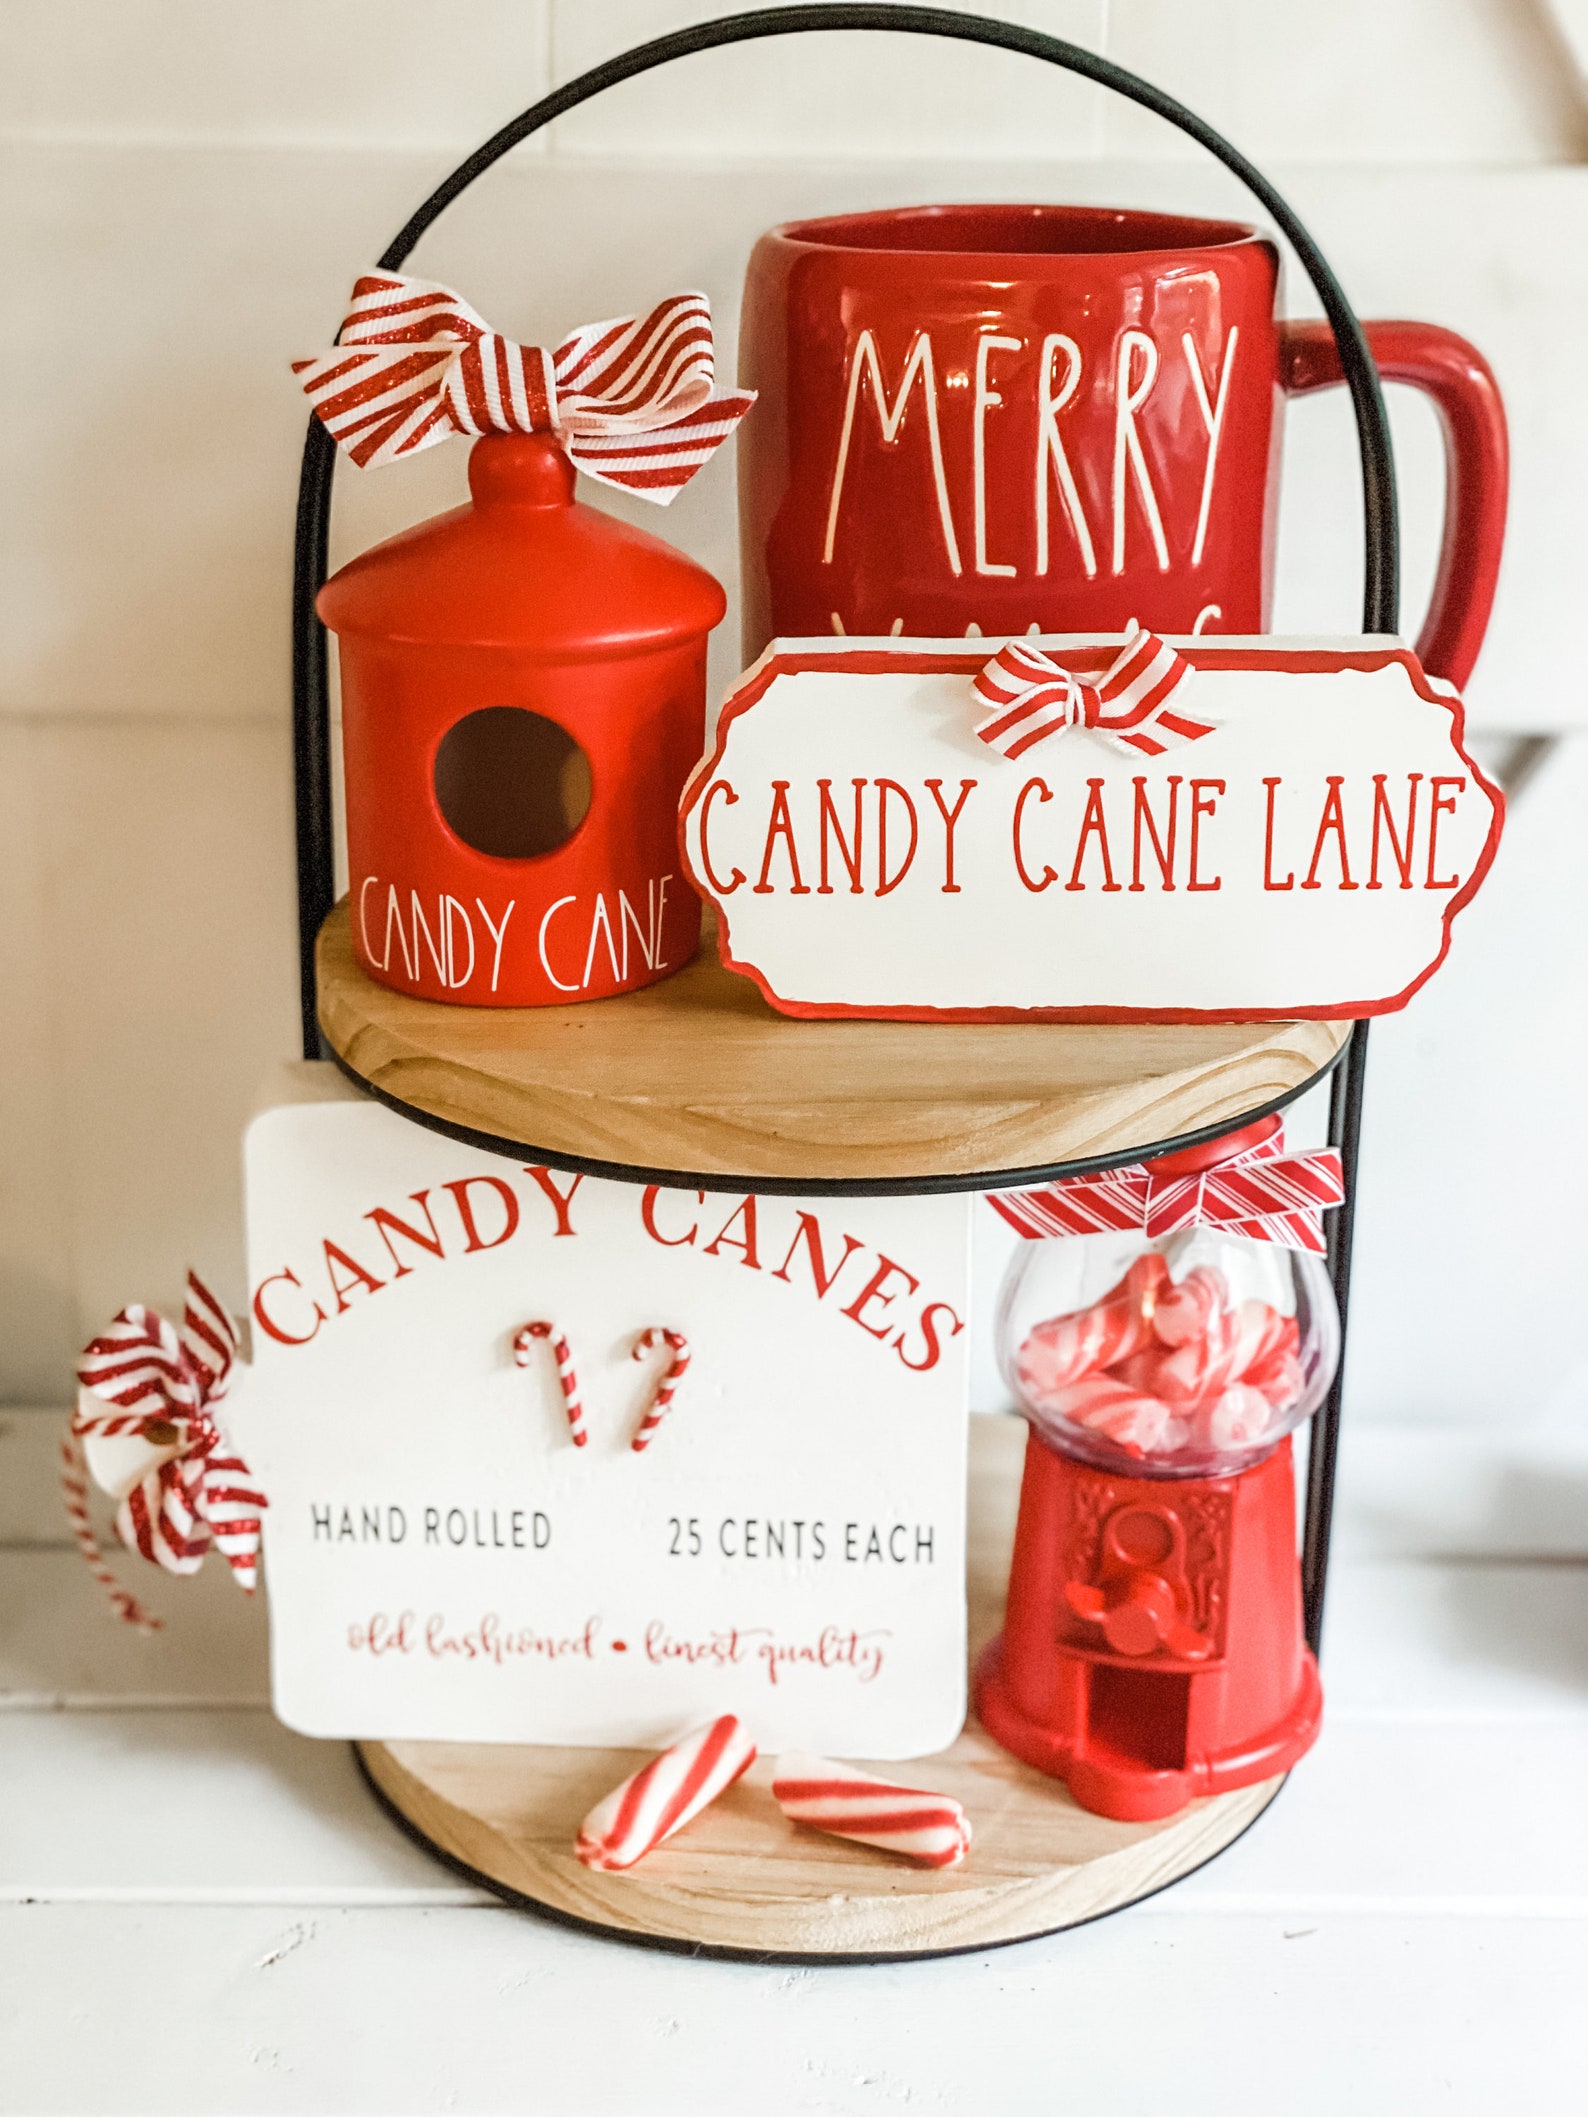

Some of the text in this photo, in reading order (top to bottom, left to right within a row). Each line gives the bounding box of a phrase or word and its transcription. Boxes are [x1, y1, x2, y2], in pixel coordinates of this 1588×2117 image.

[822, 325, 1238, 578] MERRY
[699, 772, 1466, 897] CANDY CANE LANE
[361, 874, 673, 991] CANDY CANE
[252, 1166, 966, 1372] CANDY CANES
[311, 1503, 552, 1550] HAND ROLLED
[668, 1517, 935, 1564] 25 CENTS EACH
[348, 1609, 415, 1657] old
[758, 1622, 894, 1686] quality
